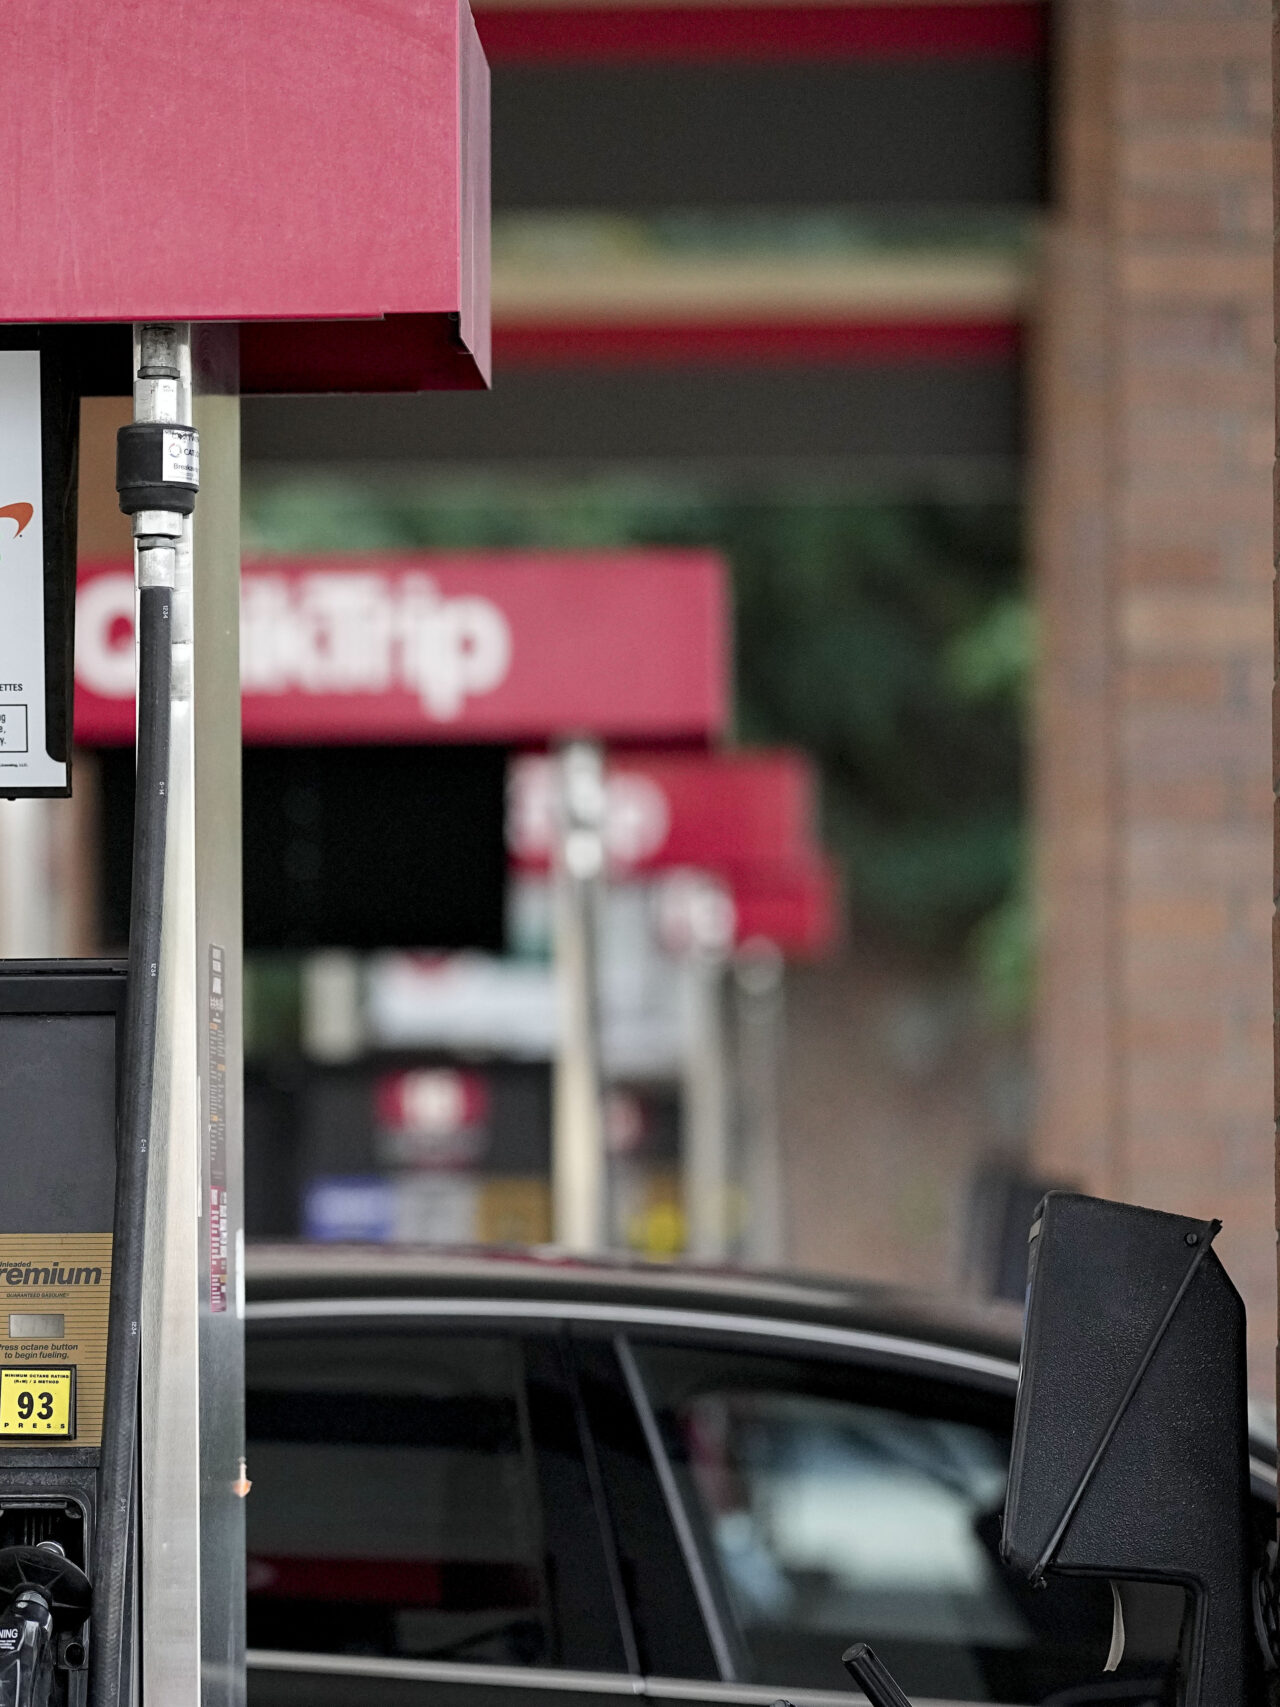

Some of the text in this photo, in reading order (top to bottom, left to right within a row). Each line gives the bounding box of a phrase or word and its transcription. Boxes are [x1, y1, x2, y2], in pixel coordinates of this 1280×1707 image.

[15, 1351, 38, 1360] begin
[39, 1351, 69, 1360] fueling.
[18, 1392, 53, 1419] 93
